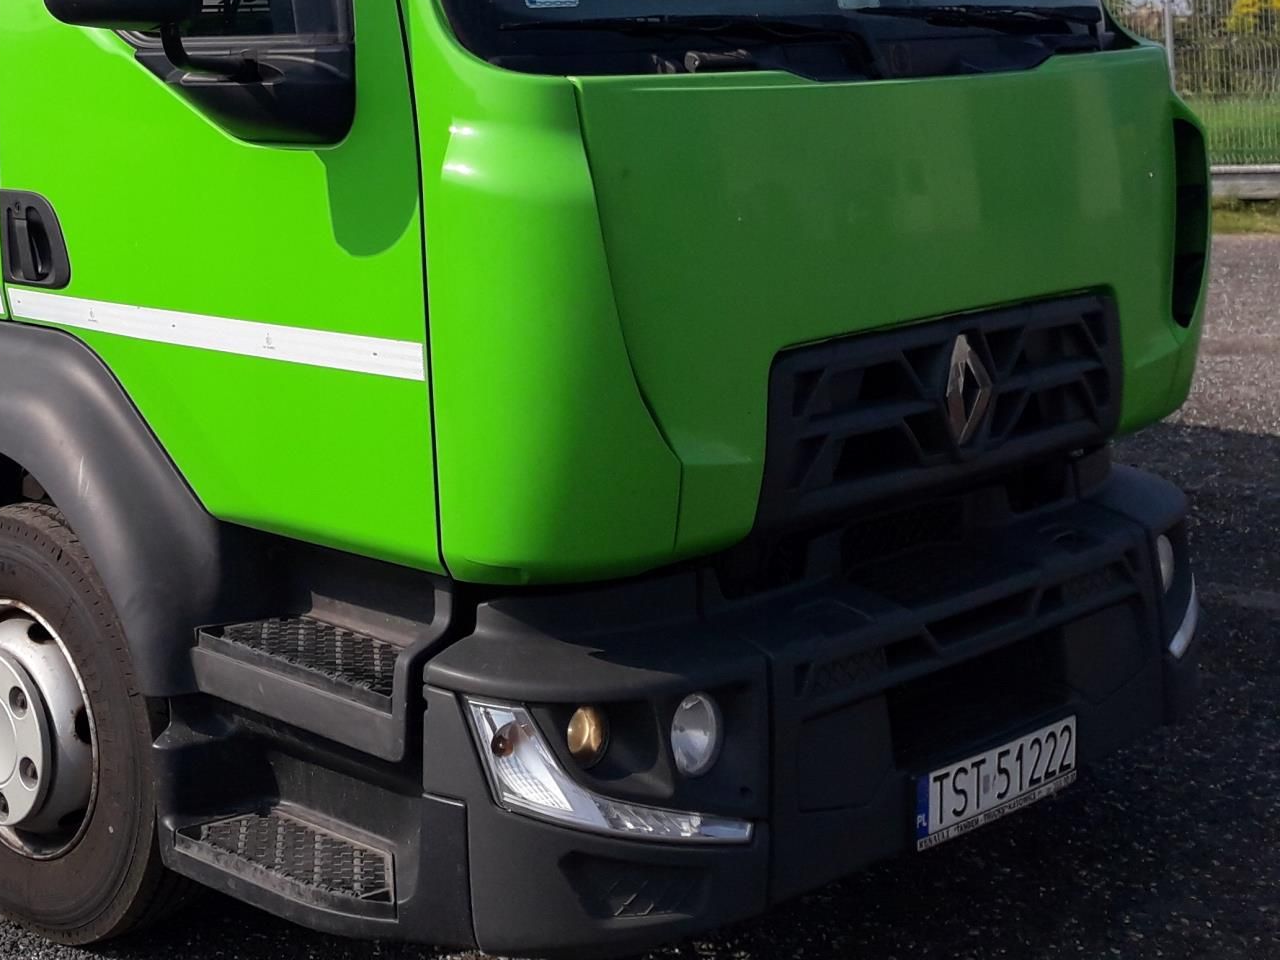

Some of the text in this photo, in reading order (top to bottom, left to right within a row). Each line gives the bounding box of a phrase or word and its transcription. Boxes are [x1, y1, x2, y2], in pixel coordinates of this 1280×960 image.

[932, 724, 1072, 825] TST 51222
[917, 815, 928, 827] PL
